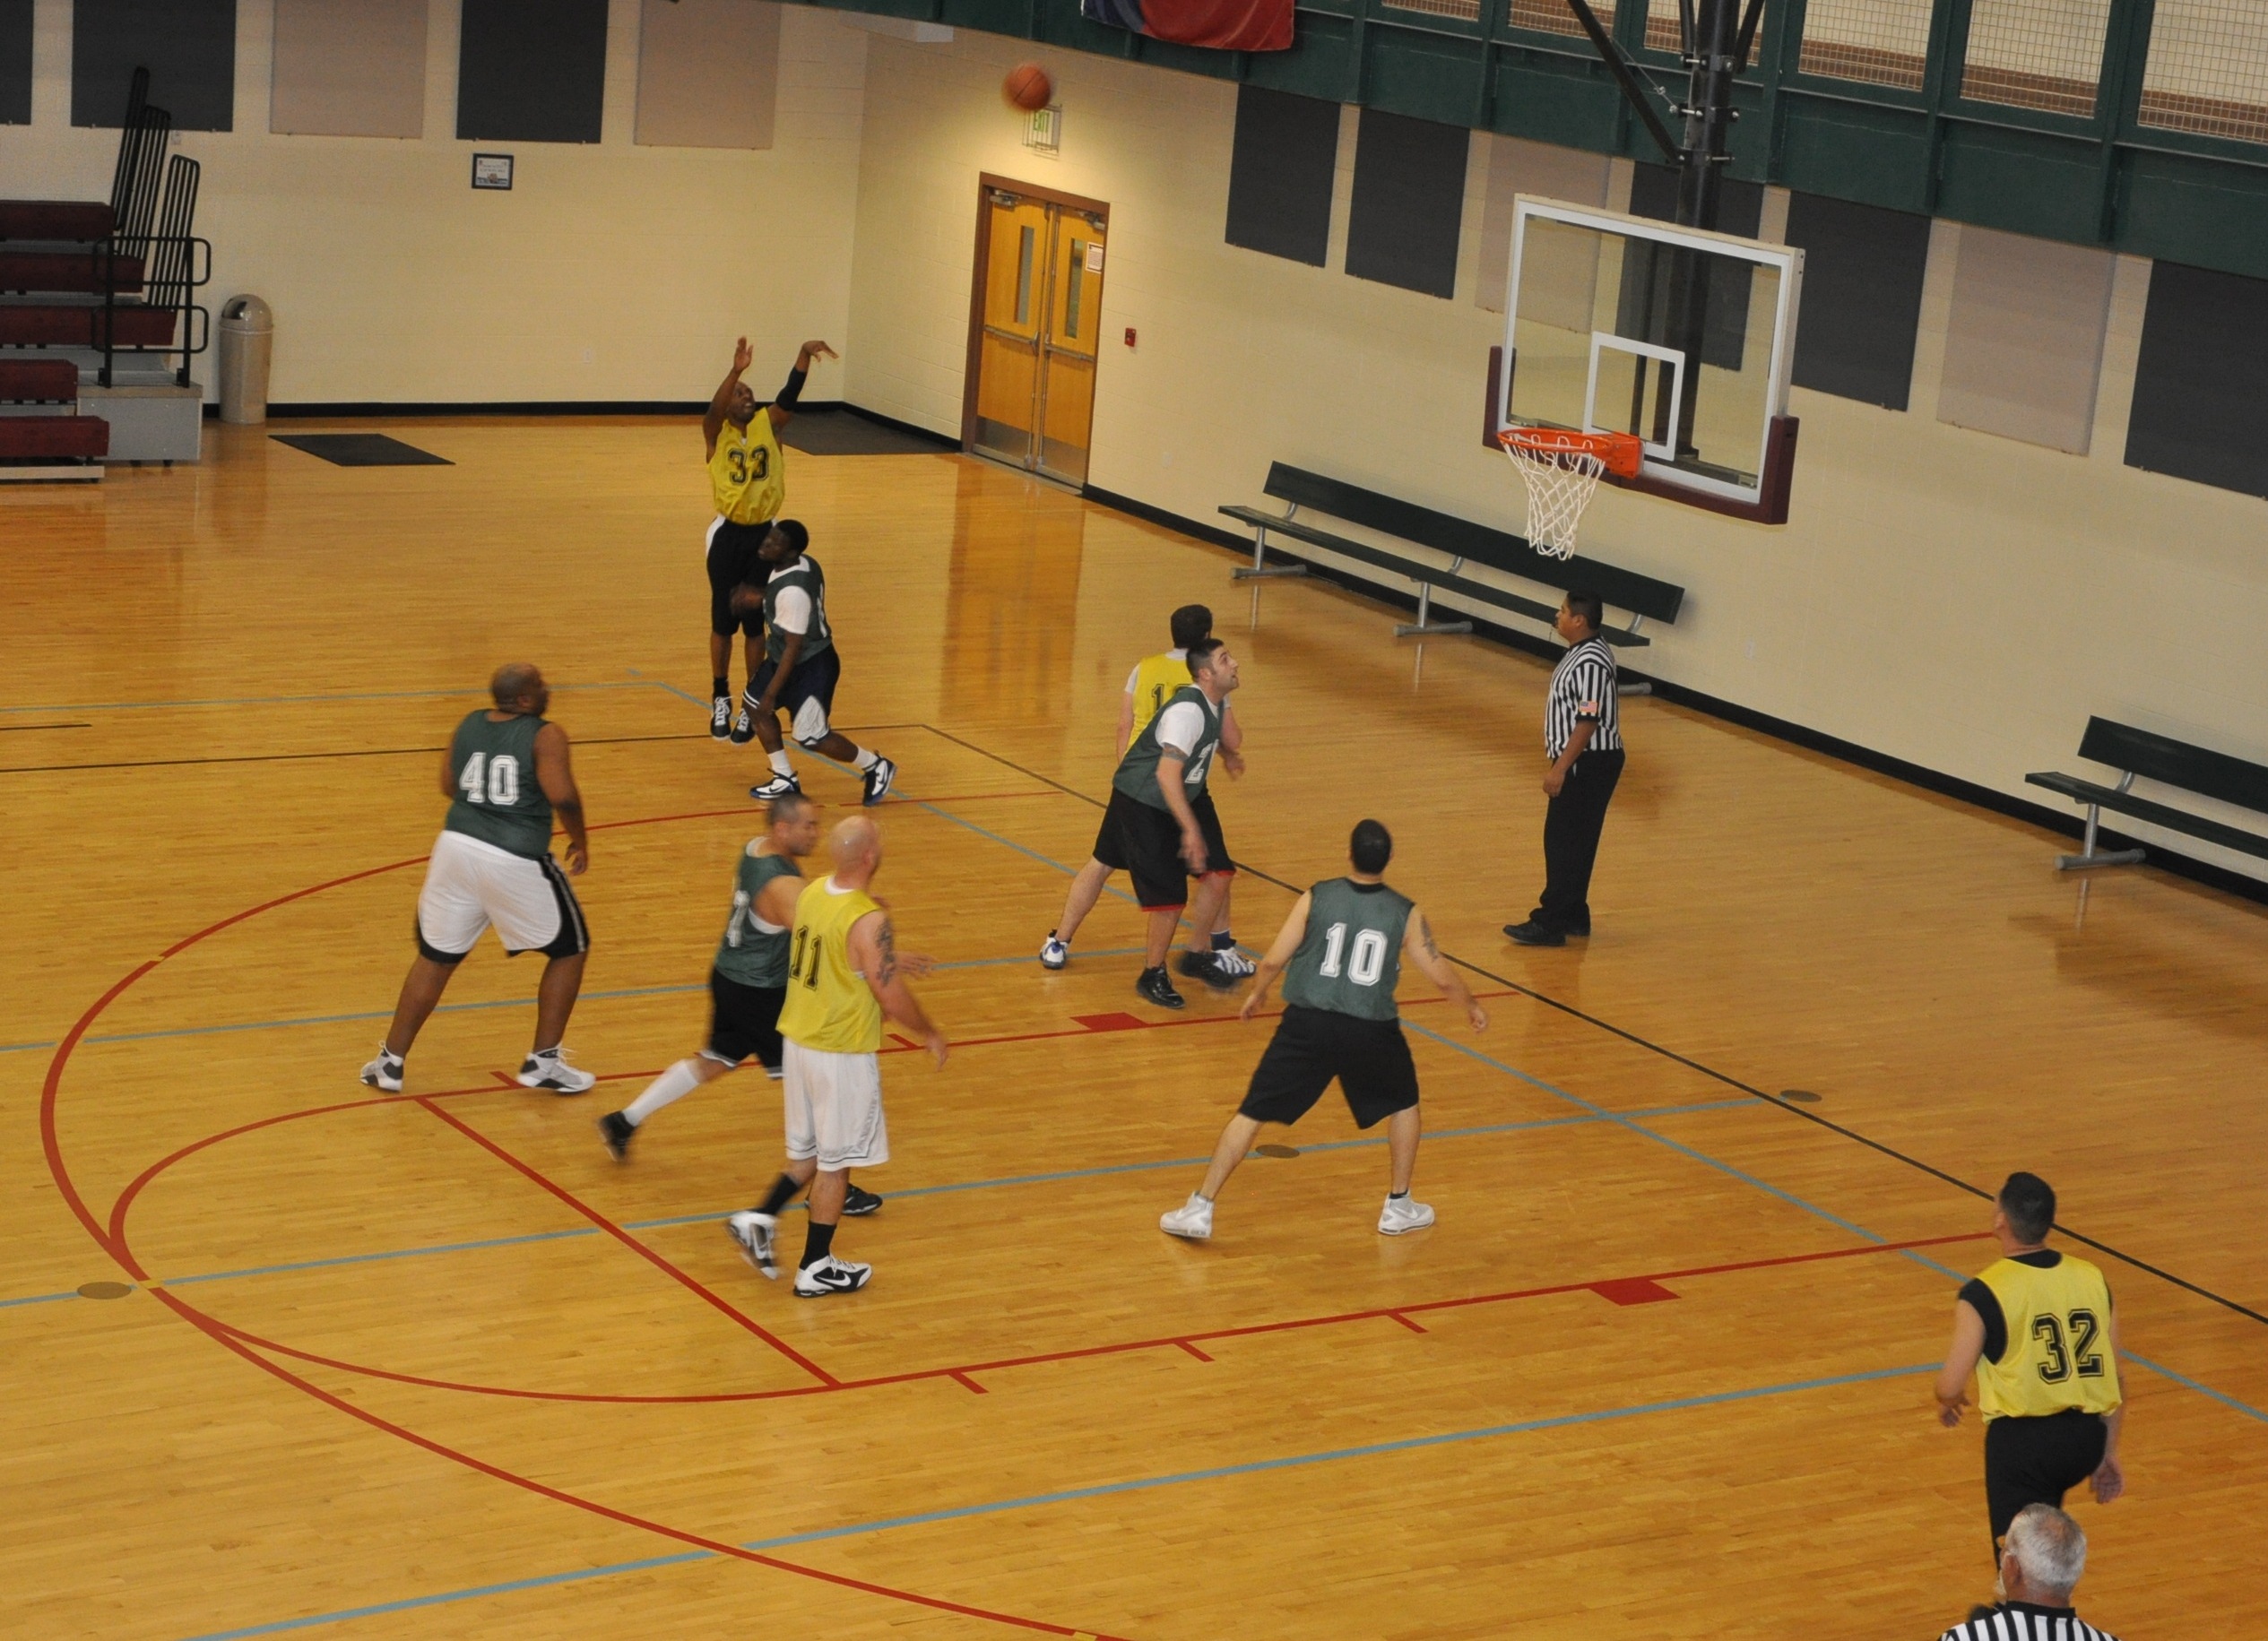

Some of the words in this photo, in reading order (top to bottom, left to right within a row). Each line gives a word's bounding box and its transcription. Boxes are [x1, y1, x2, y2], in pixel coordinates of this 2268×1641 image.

[728, 445, 770, 485] 33
[459, 752, 519, 805] 40
[789, 925, 822, 991] 11
[1320, 922, 1388, 987] 10
[2031, 1308, 2104, 1385] 32
